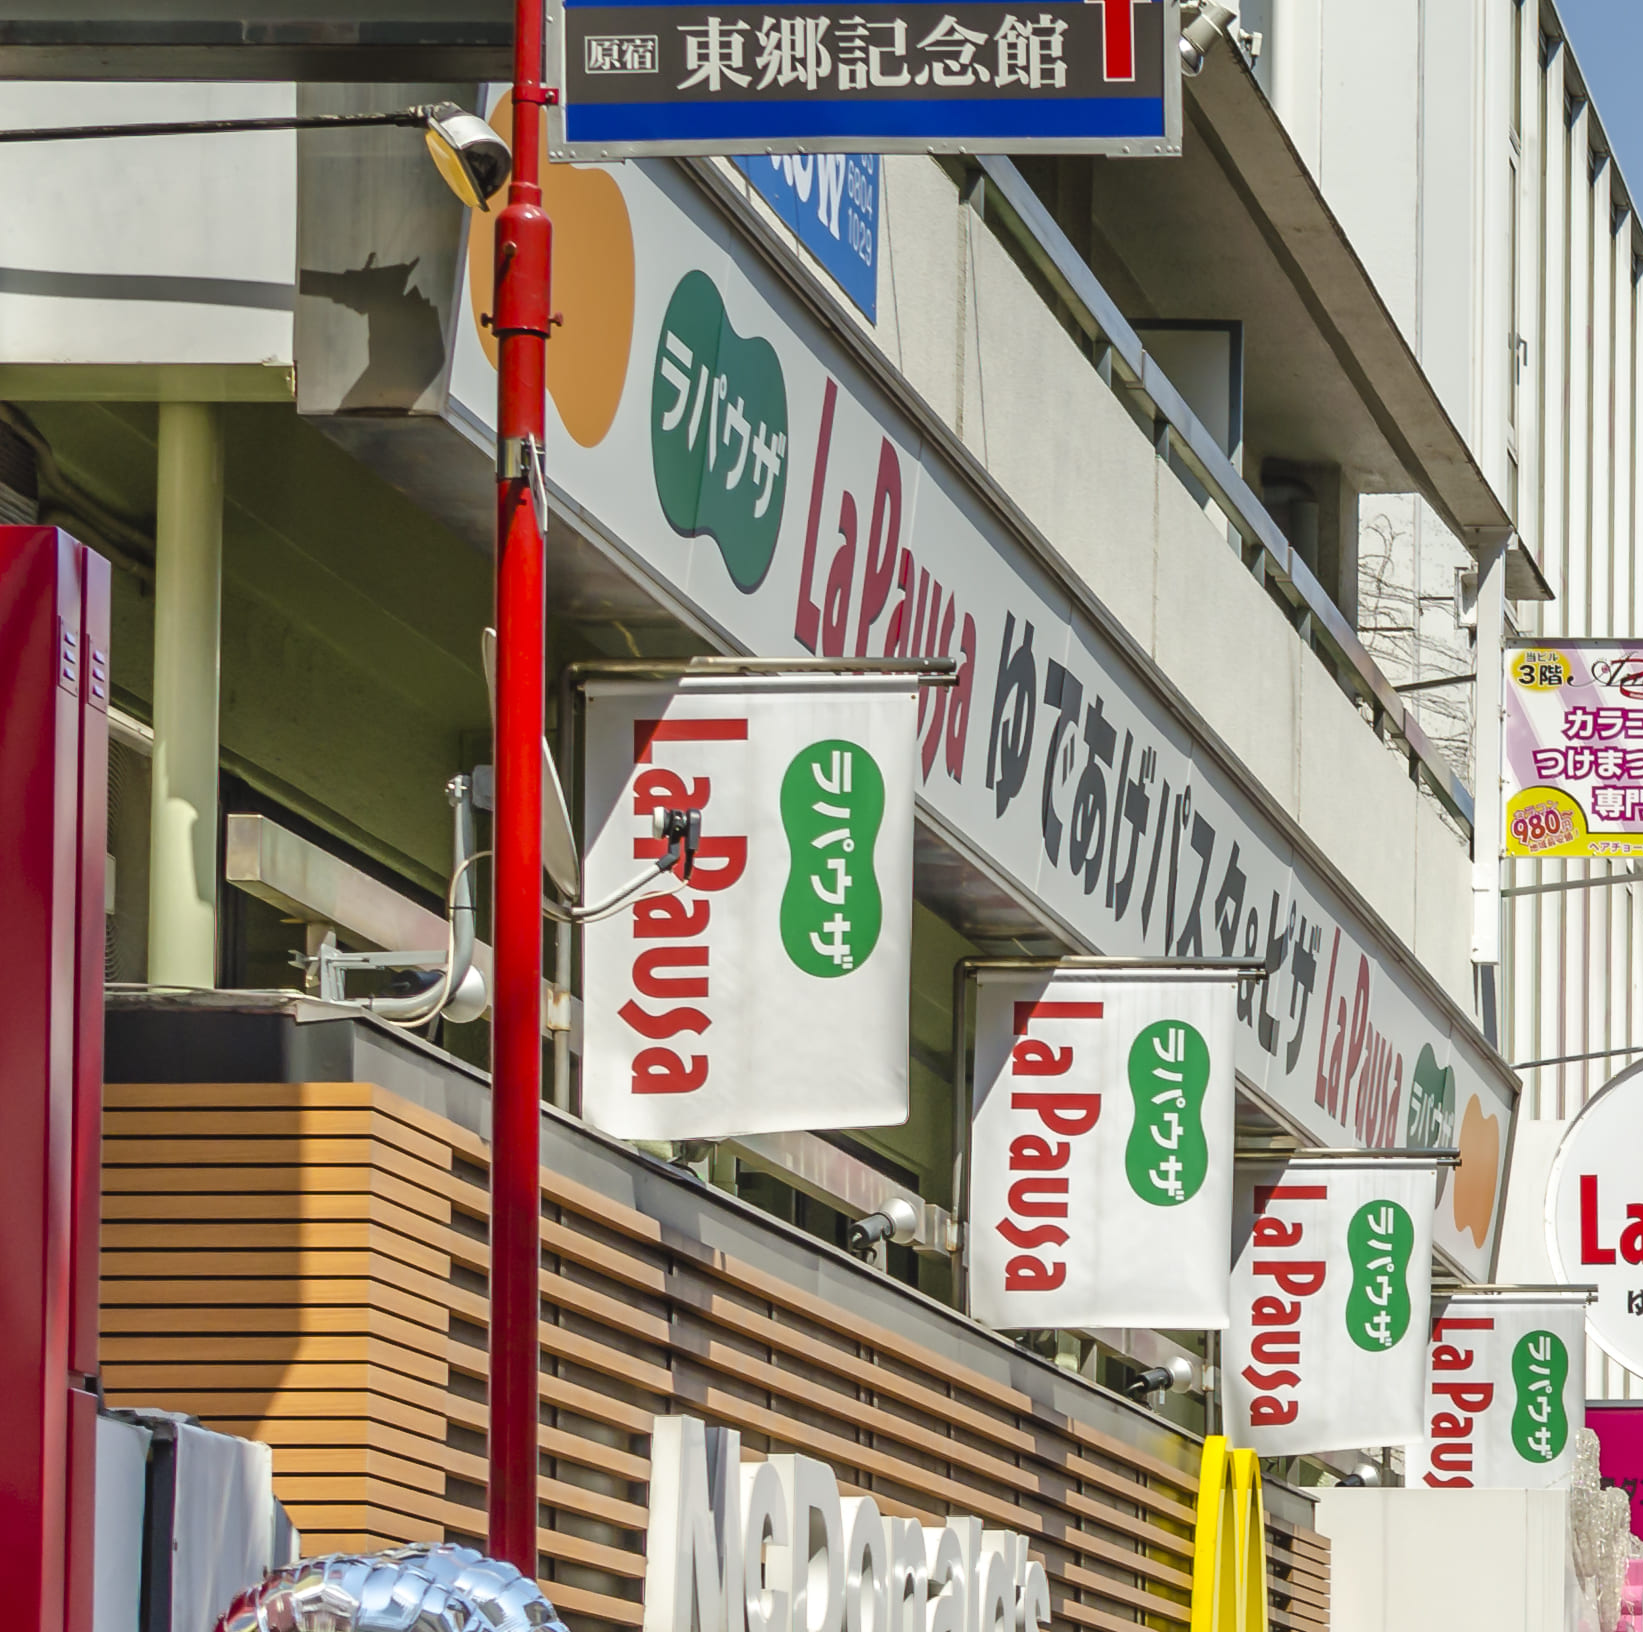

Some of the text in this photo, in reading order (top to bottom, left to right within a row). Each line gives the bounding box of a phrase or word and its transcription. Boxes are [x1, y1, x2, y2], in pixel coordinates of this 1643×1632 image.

[587, 14, 1068, 93] 原宿 東郷記念館
[848, 160, 873, 221] 6804
[848, 207, 872, 267] 1029
[660, 330, 786, 520] ラパウザ
[1518, 664, 1563, 685] 3階
[809, 749, 854, 970] ラパウザ
[1150, 1026, 1185, 1203] ラパウザ
[1363, 1206, 1395, 1347] ラパウザ
[1526, 1335, 1552, 1461] ラパウザ
